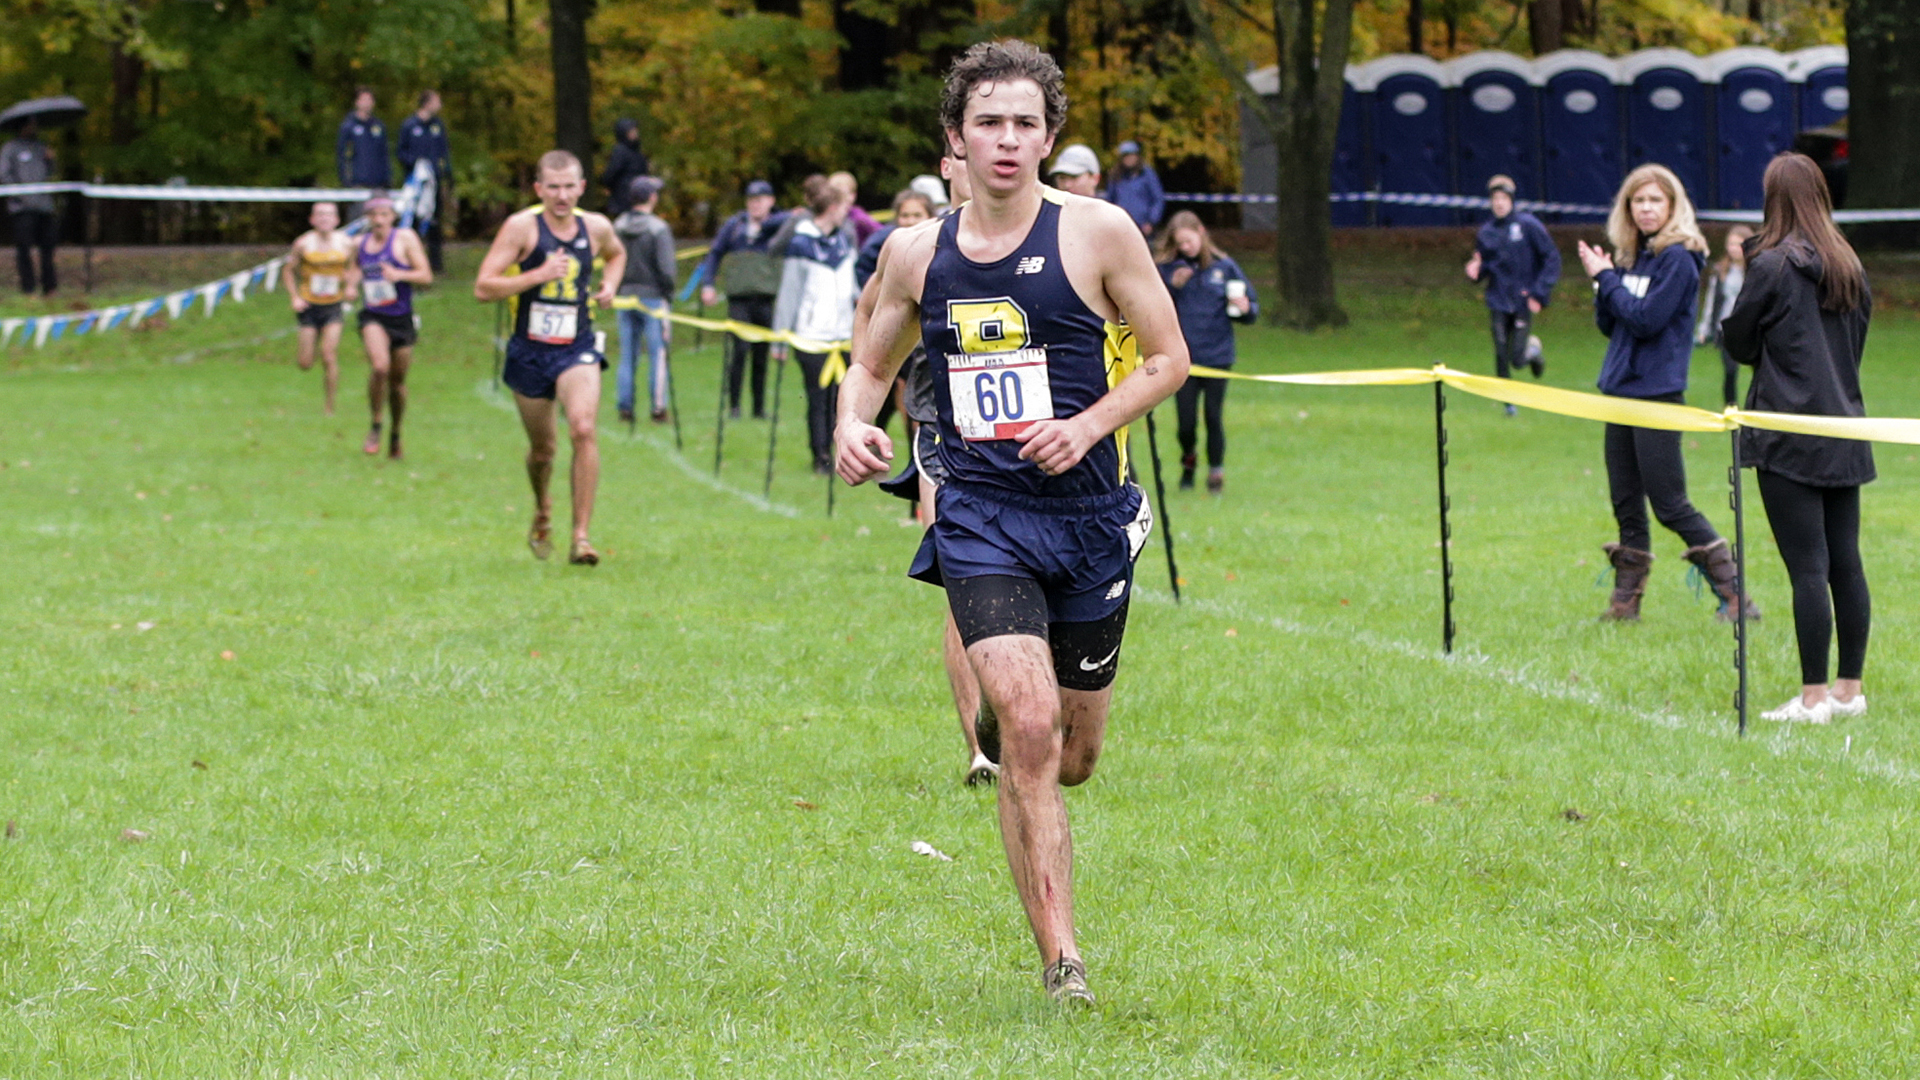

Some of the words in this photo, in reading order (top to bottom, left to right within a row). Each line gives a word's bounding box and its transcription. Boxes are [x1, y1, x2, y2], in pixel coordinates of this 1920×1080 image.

[1015, 256, 1045, 275] NB
[542, 313, 565, 335] 57
[975, 370, 1024, 422] 60
